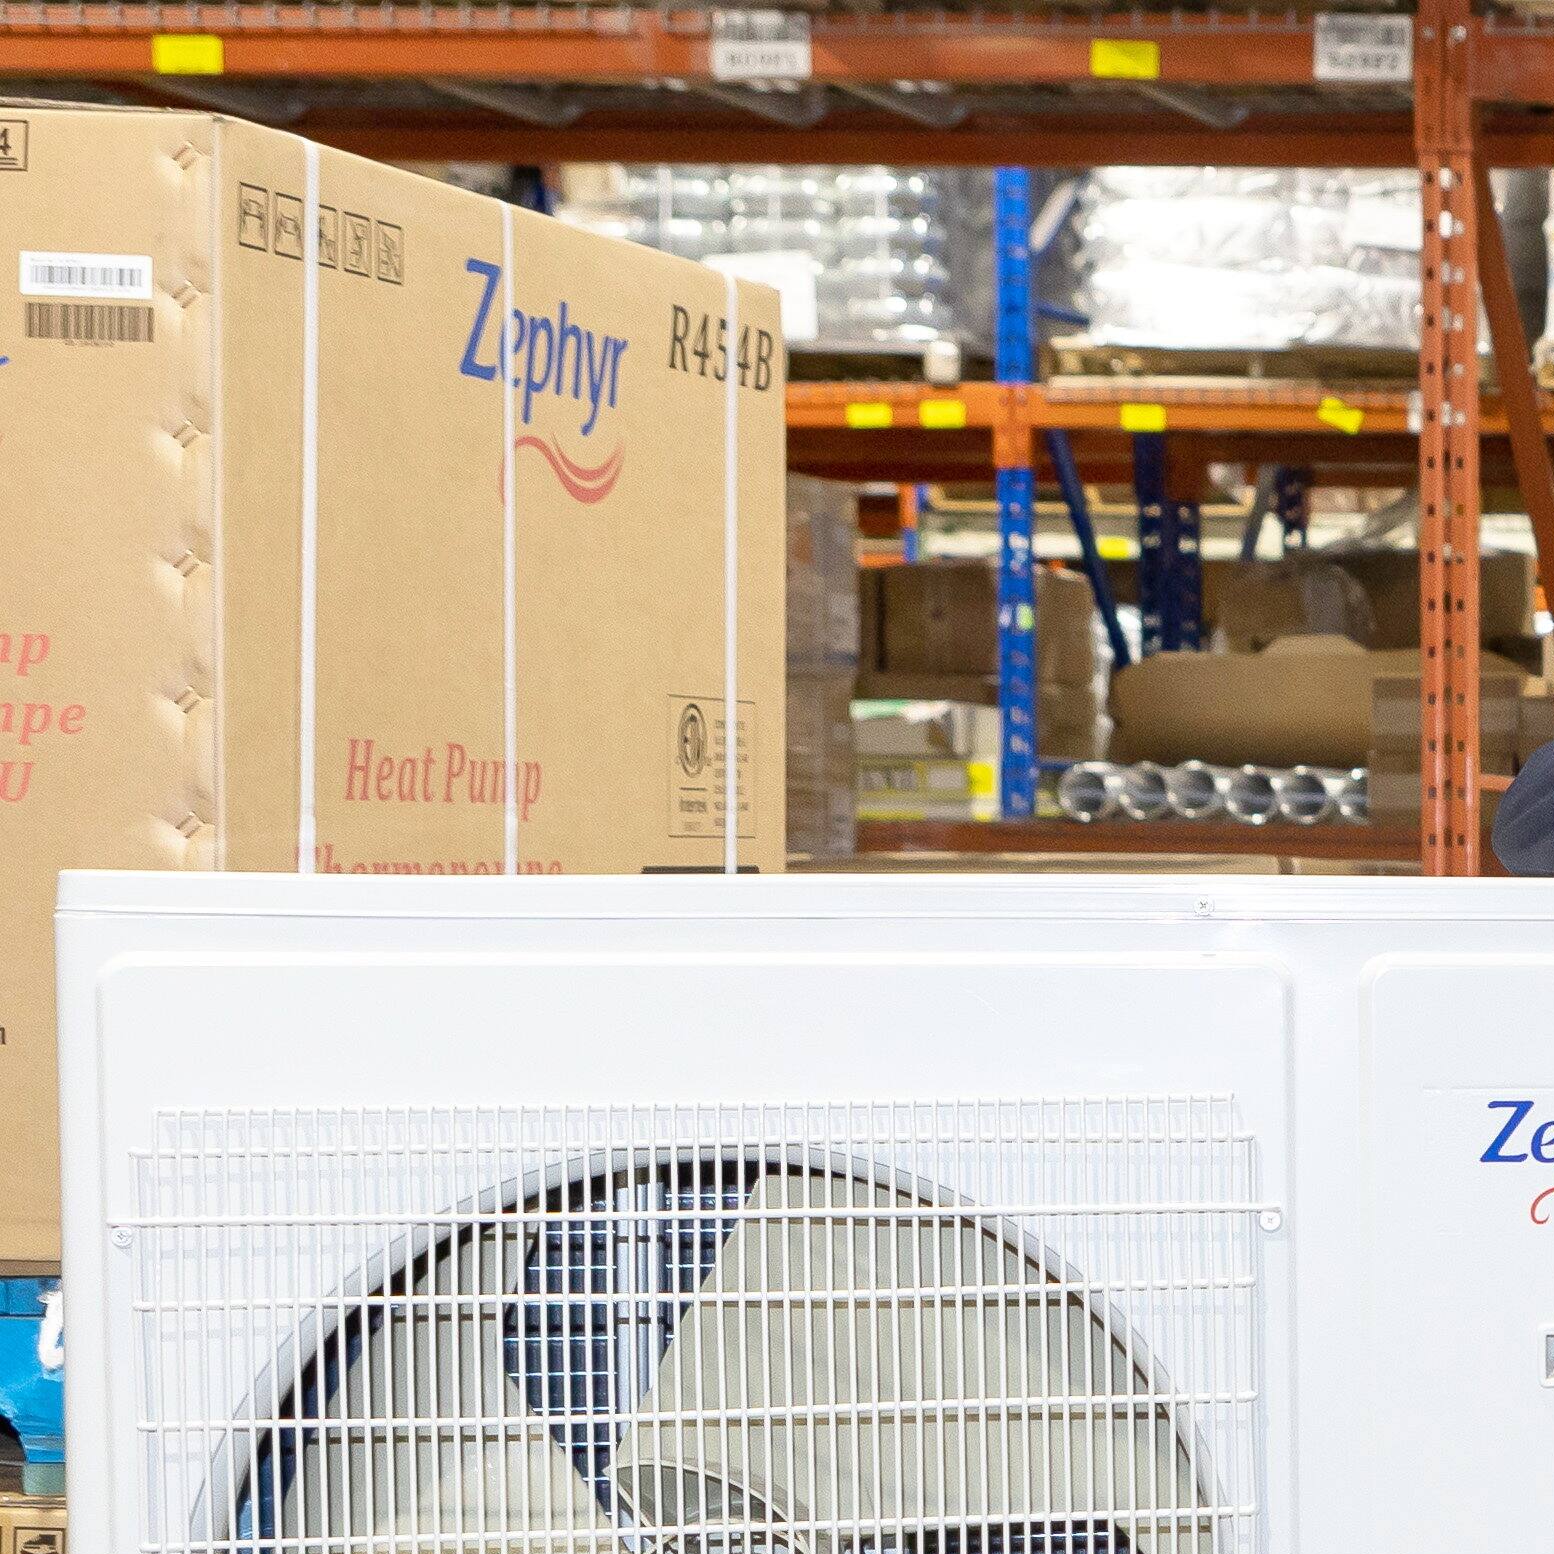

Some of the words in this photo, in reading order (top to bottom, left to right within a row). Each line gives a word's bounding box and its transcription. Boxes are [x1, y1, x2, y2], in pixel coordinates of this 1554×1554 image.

[460, 257, 628, 437] Zephyr
[669, 304, 774, 392] R454B
[345, 737, 435, 802] Heat
